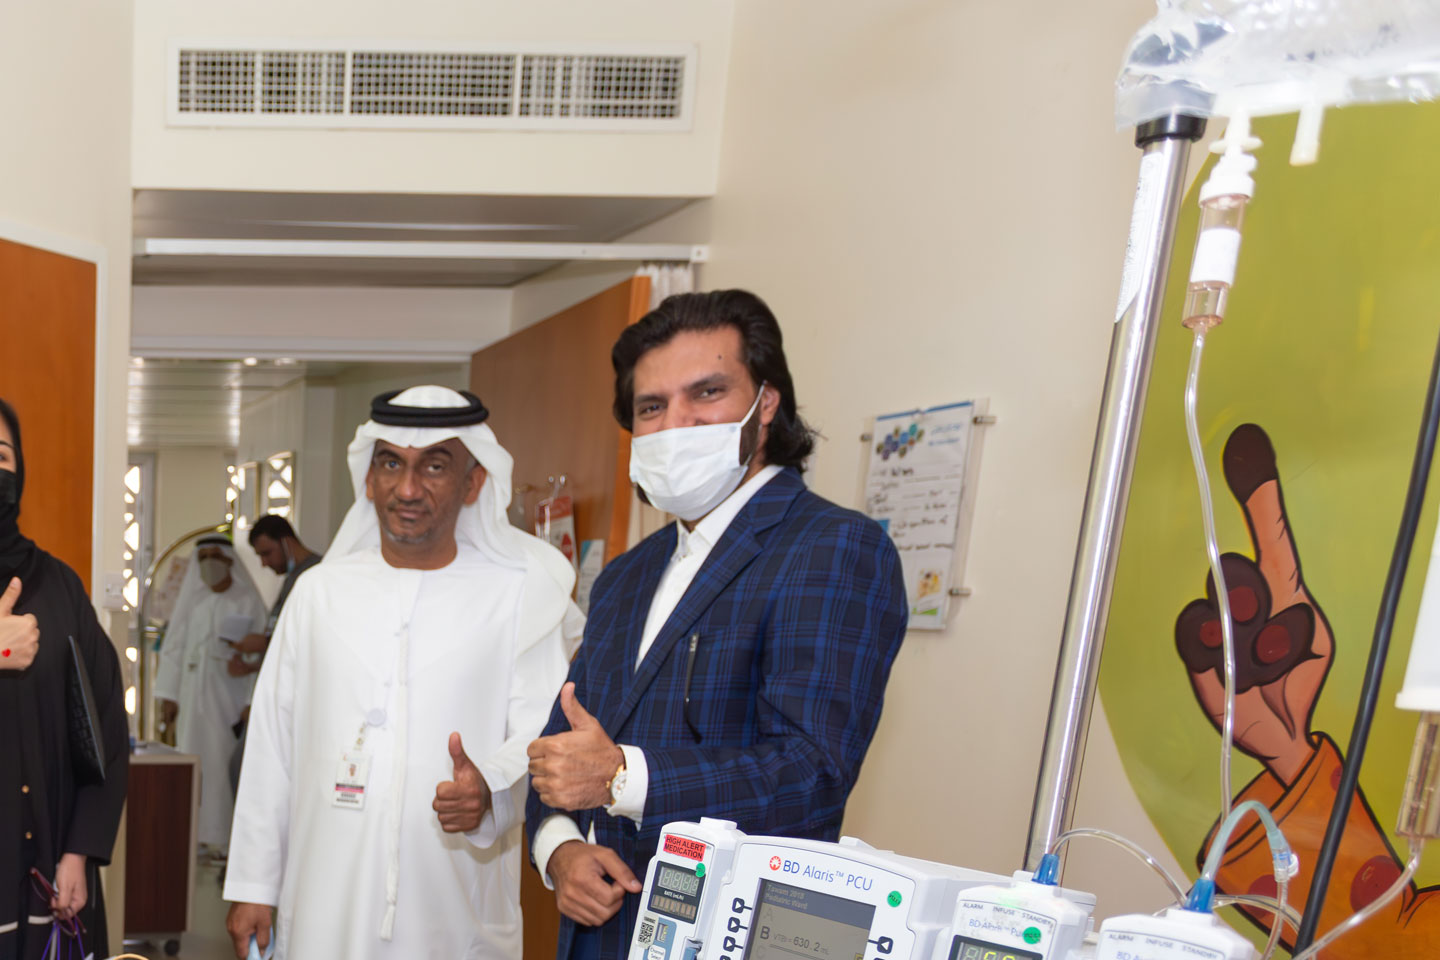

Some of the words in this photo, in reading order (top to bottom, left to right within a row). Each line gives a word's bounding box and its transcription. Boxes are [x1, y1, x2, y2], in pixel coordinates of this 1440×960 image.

[665, 843, 703, 859] MEDICATION
[666, 837, 681, 846] HIGH
[682, 841, 704, 852] ALERT
[783, 860, 800, 874] BD
[846, 874, 873, 891] PCU
[963, 902, 984, 910] ALARM
[992, 906, 1015, 916] INFUSE
[760, 925, 770, 939] B
